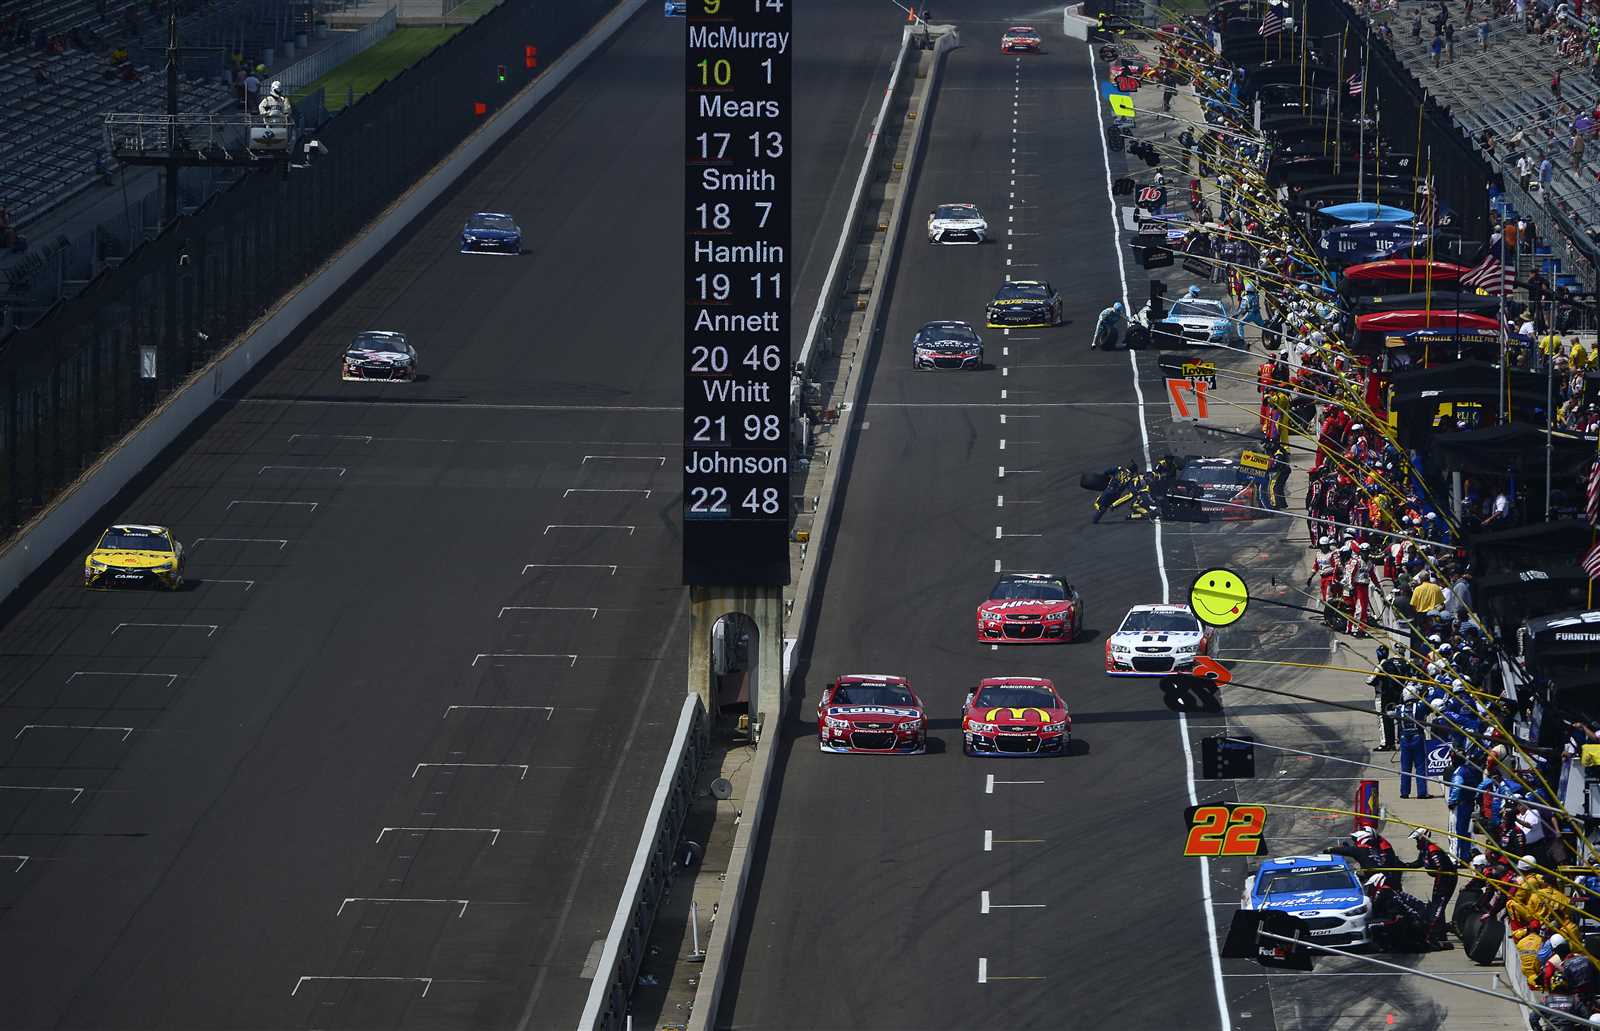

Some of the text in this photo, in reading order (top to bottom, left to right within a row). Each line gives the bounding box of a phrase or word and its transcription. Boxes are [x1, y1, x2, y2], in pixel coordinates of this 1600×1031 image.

[689, 26, 789, 54] McMurray
[697, 59, 772, 85] 10 1
[700, 95, 779, 117] Mears
[697, 132, 783, 158] 17 13
[702, 168, 775, 190] Smith
[696, 202, 772, 229] 18 7
[694, 240, 783, 263] Hamlin
[696, 273, 781, 300] 19 11
[694, 309, 779, 331] Annett
[691, 345, 781, 372] 20 46
[703, 380, 770, 402] Whitt
[693, 415, 780, 441] 21 98
[685, 451, 787, 473] Johnson
[690, 487, 779, 513] 22 48
[1184, 806, 1266, 856] 22
